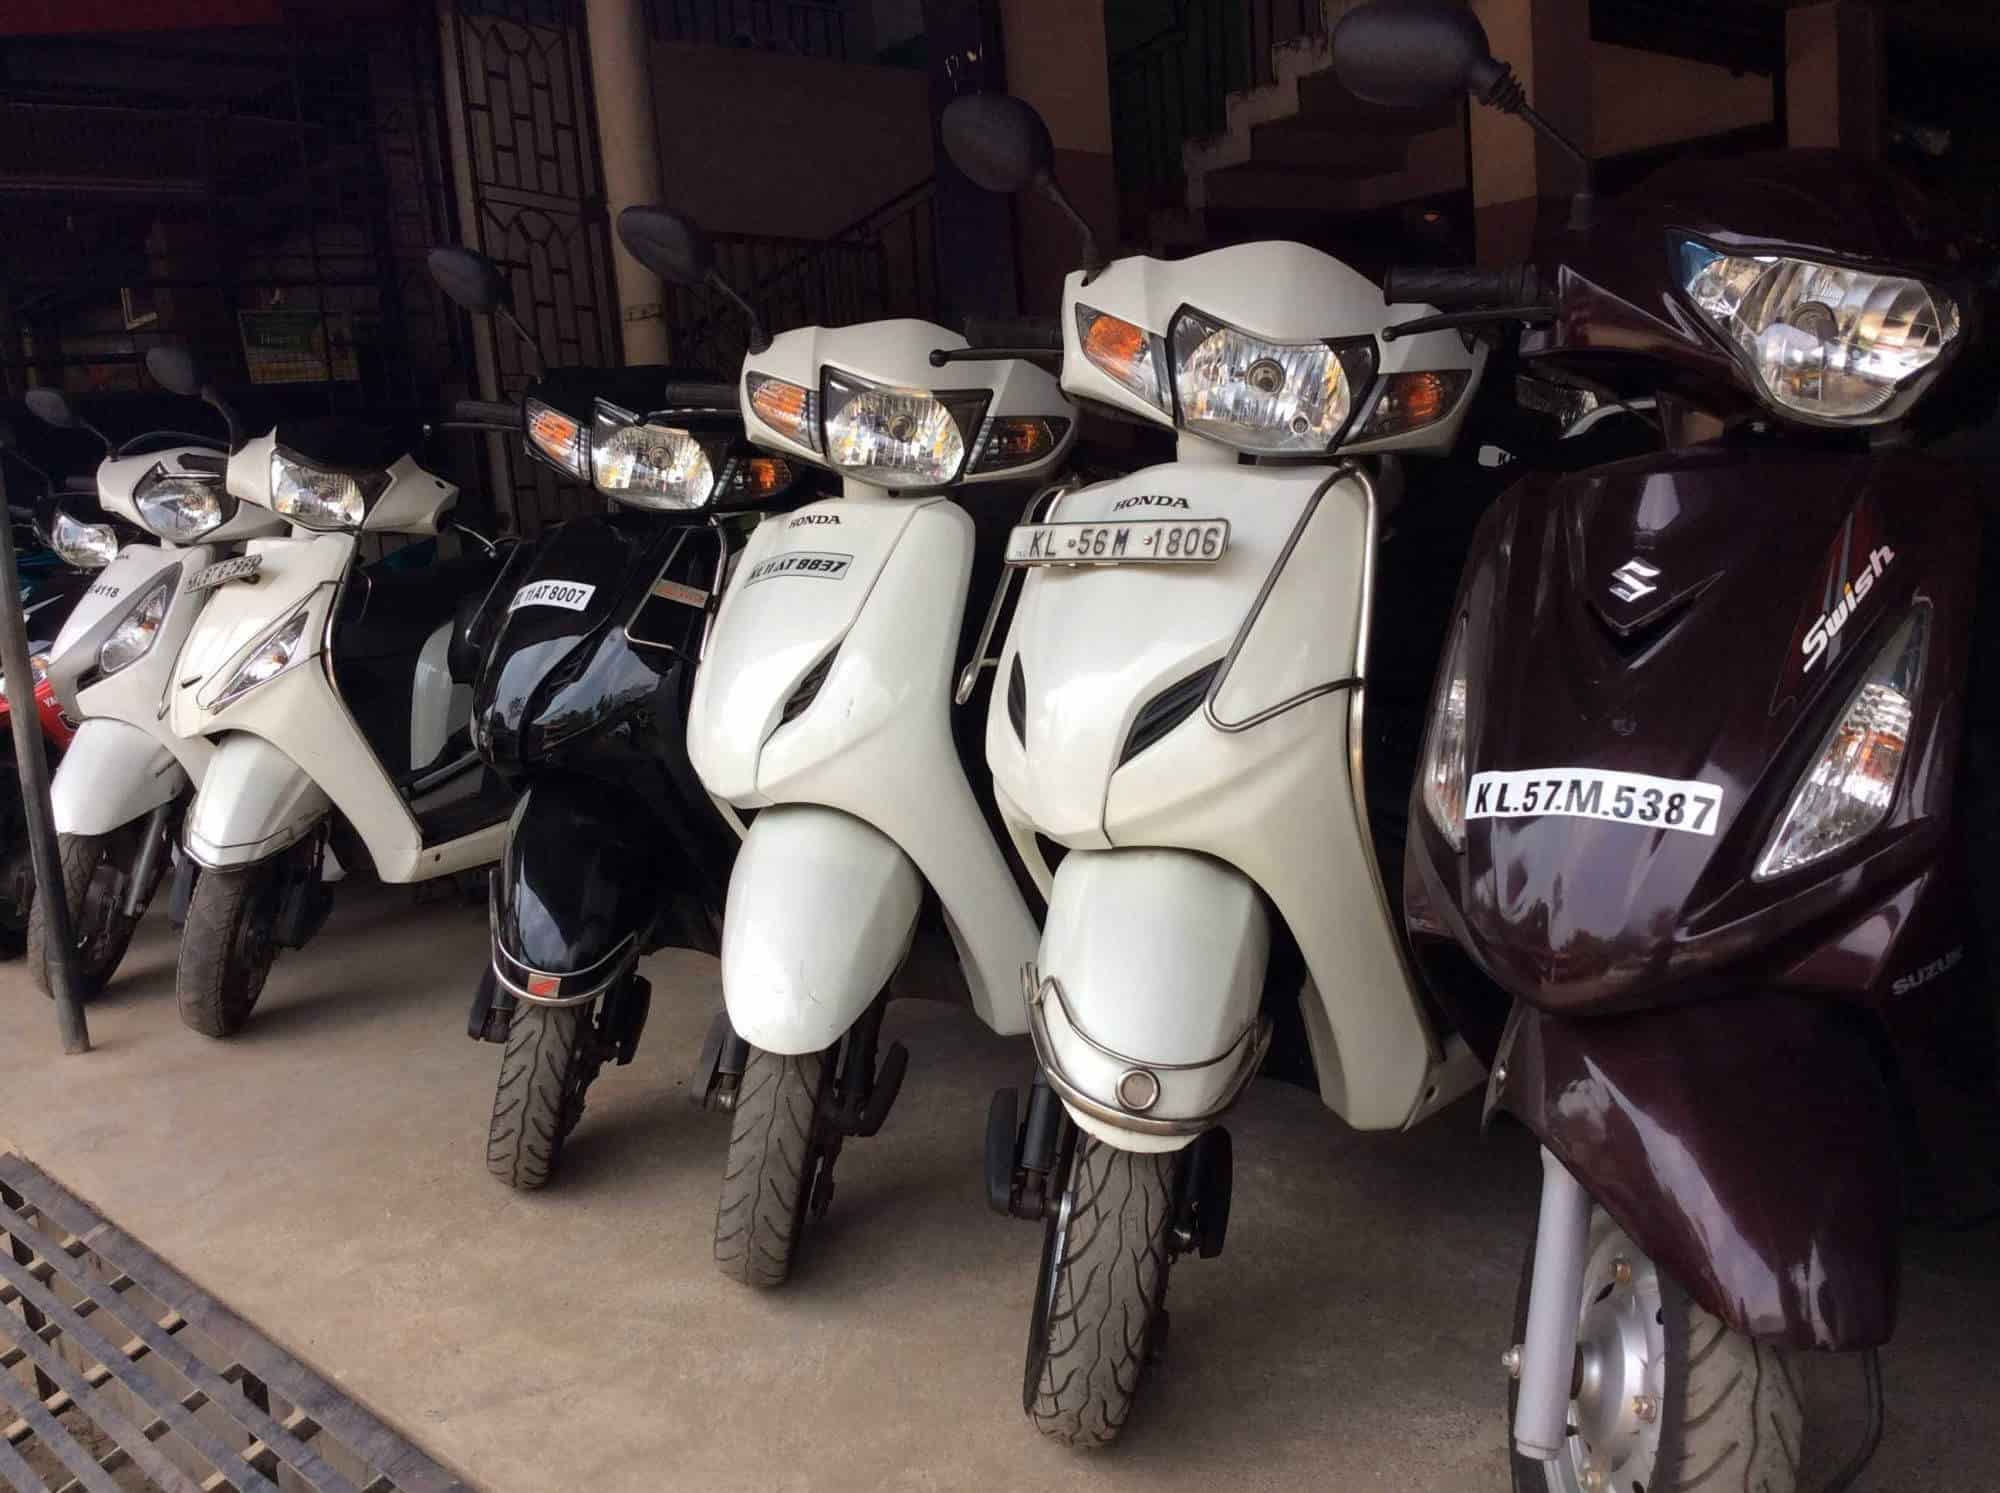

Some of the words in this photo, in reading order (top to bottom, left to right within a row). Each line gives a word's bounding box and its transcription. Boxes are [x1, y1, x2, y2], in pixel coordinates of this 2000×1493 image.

[1112, 495, 1190, 512] HONDA
[788, 514, 841, 529] HONDA
[1029, 530, 1056, 558] KL
[1152, 527, 1219, 556] 1806
[796, 558, 848, 573] 8837
[1802, 545, 1895, 673] Swish
[1474, 779, 1716, 830] KL.57.M.5387
